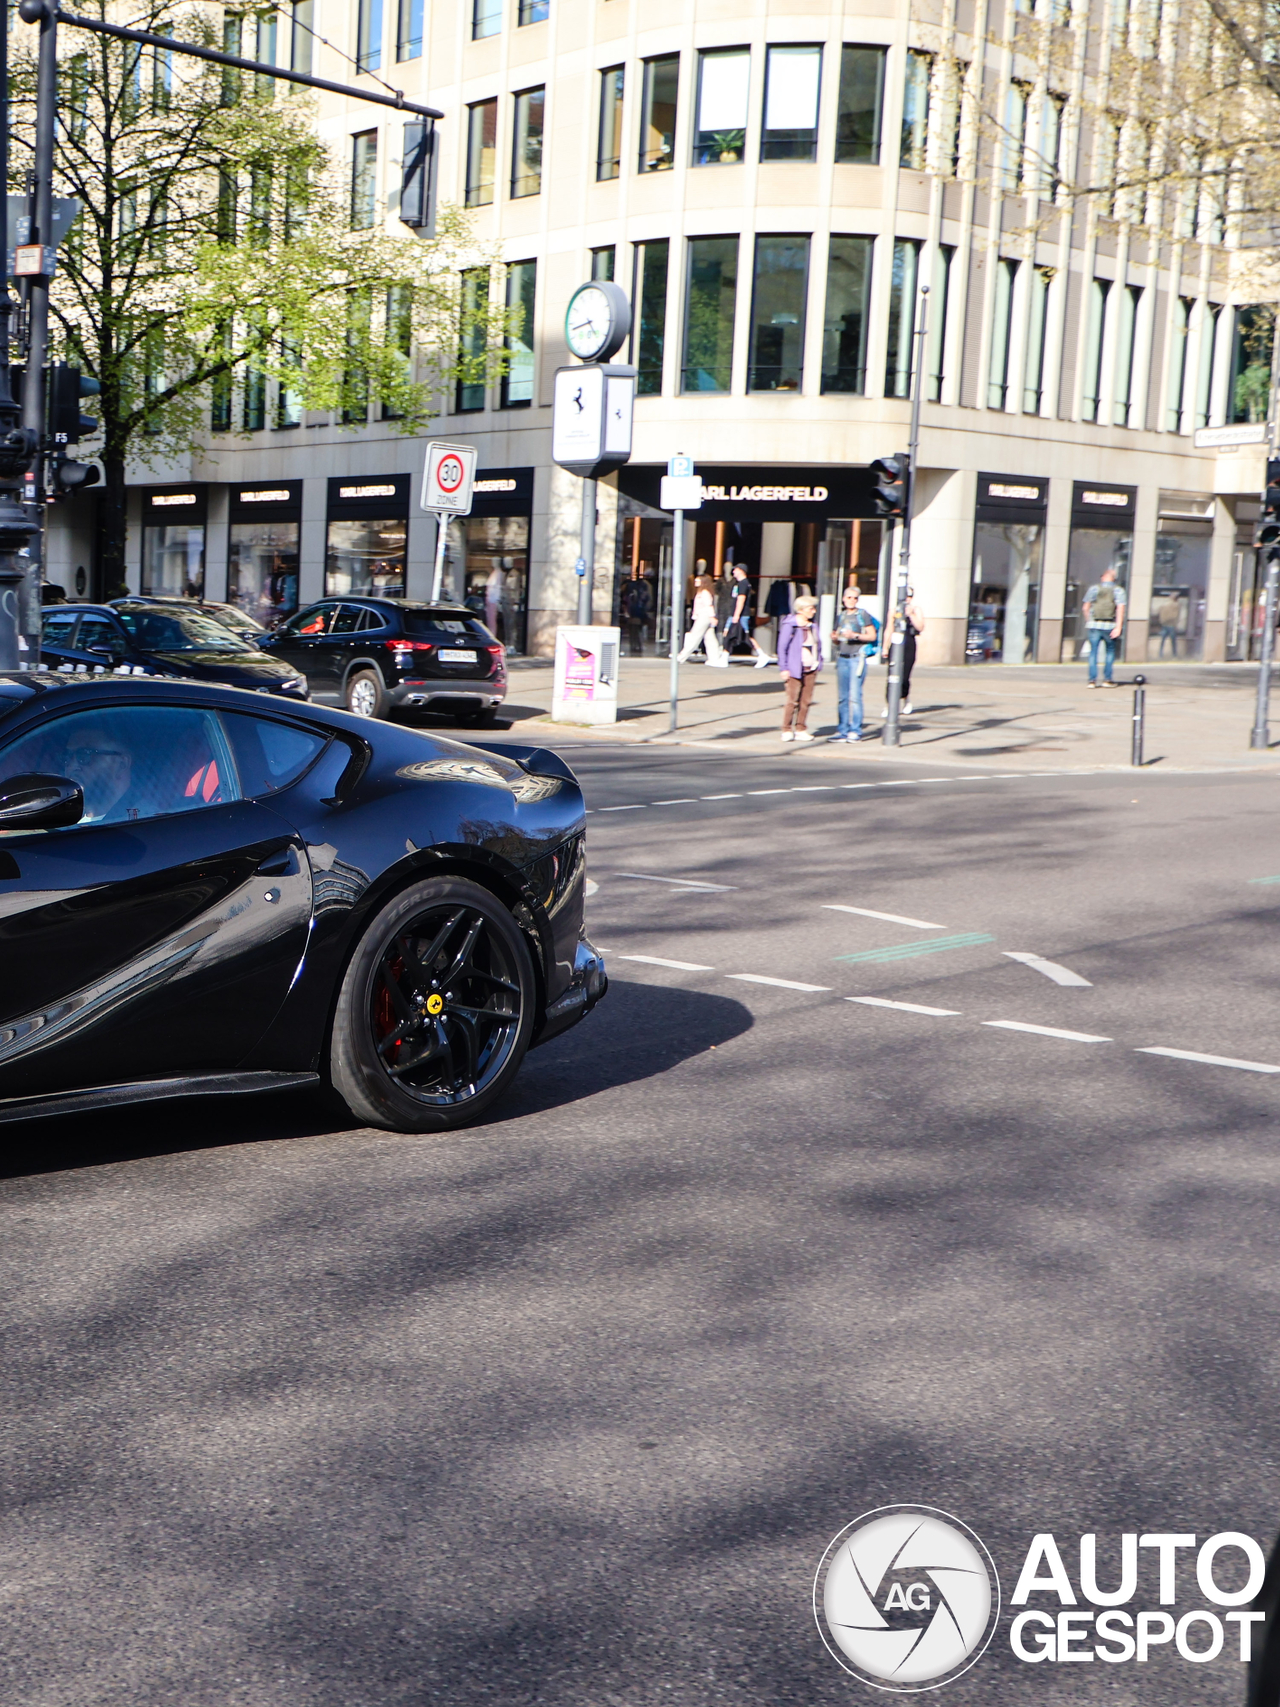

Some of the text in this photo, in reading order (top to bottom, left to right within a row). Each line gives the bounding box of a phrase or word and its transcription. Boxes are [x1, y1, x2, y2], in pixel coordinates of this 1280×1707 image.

[55, 432, 68, 443] F5
[440, 464, 459, 482] 30
[436, 494, 458, 506] ZONE
[700, 485, 829, 502] ARL LAGERFELD
[387, 888, 435, 922] ZERO
